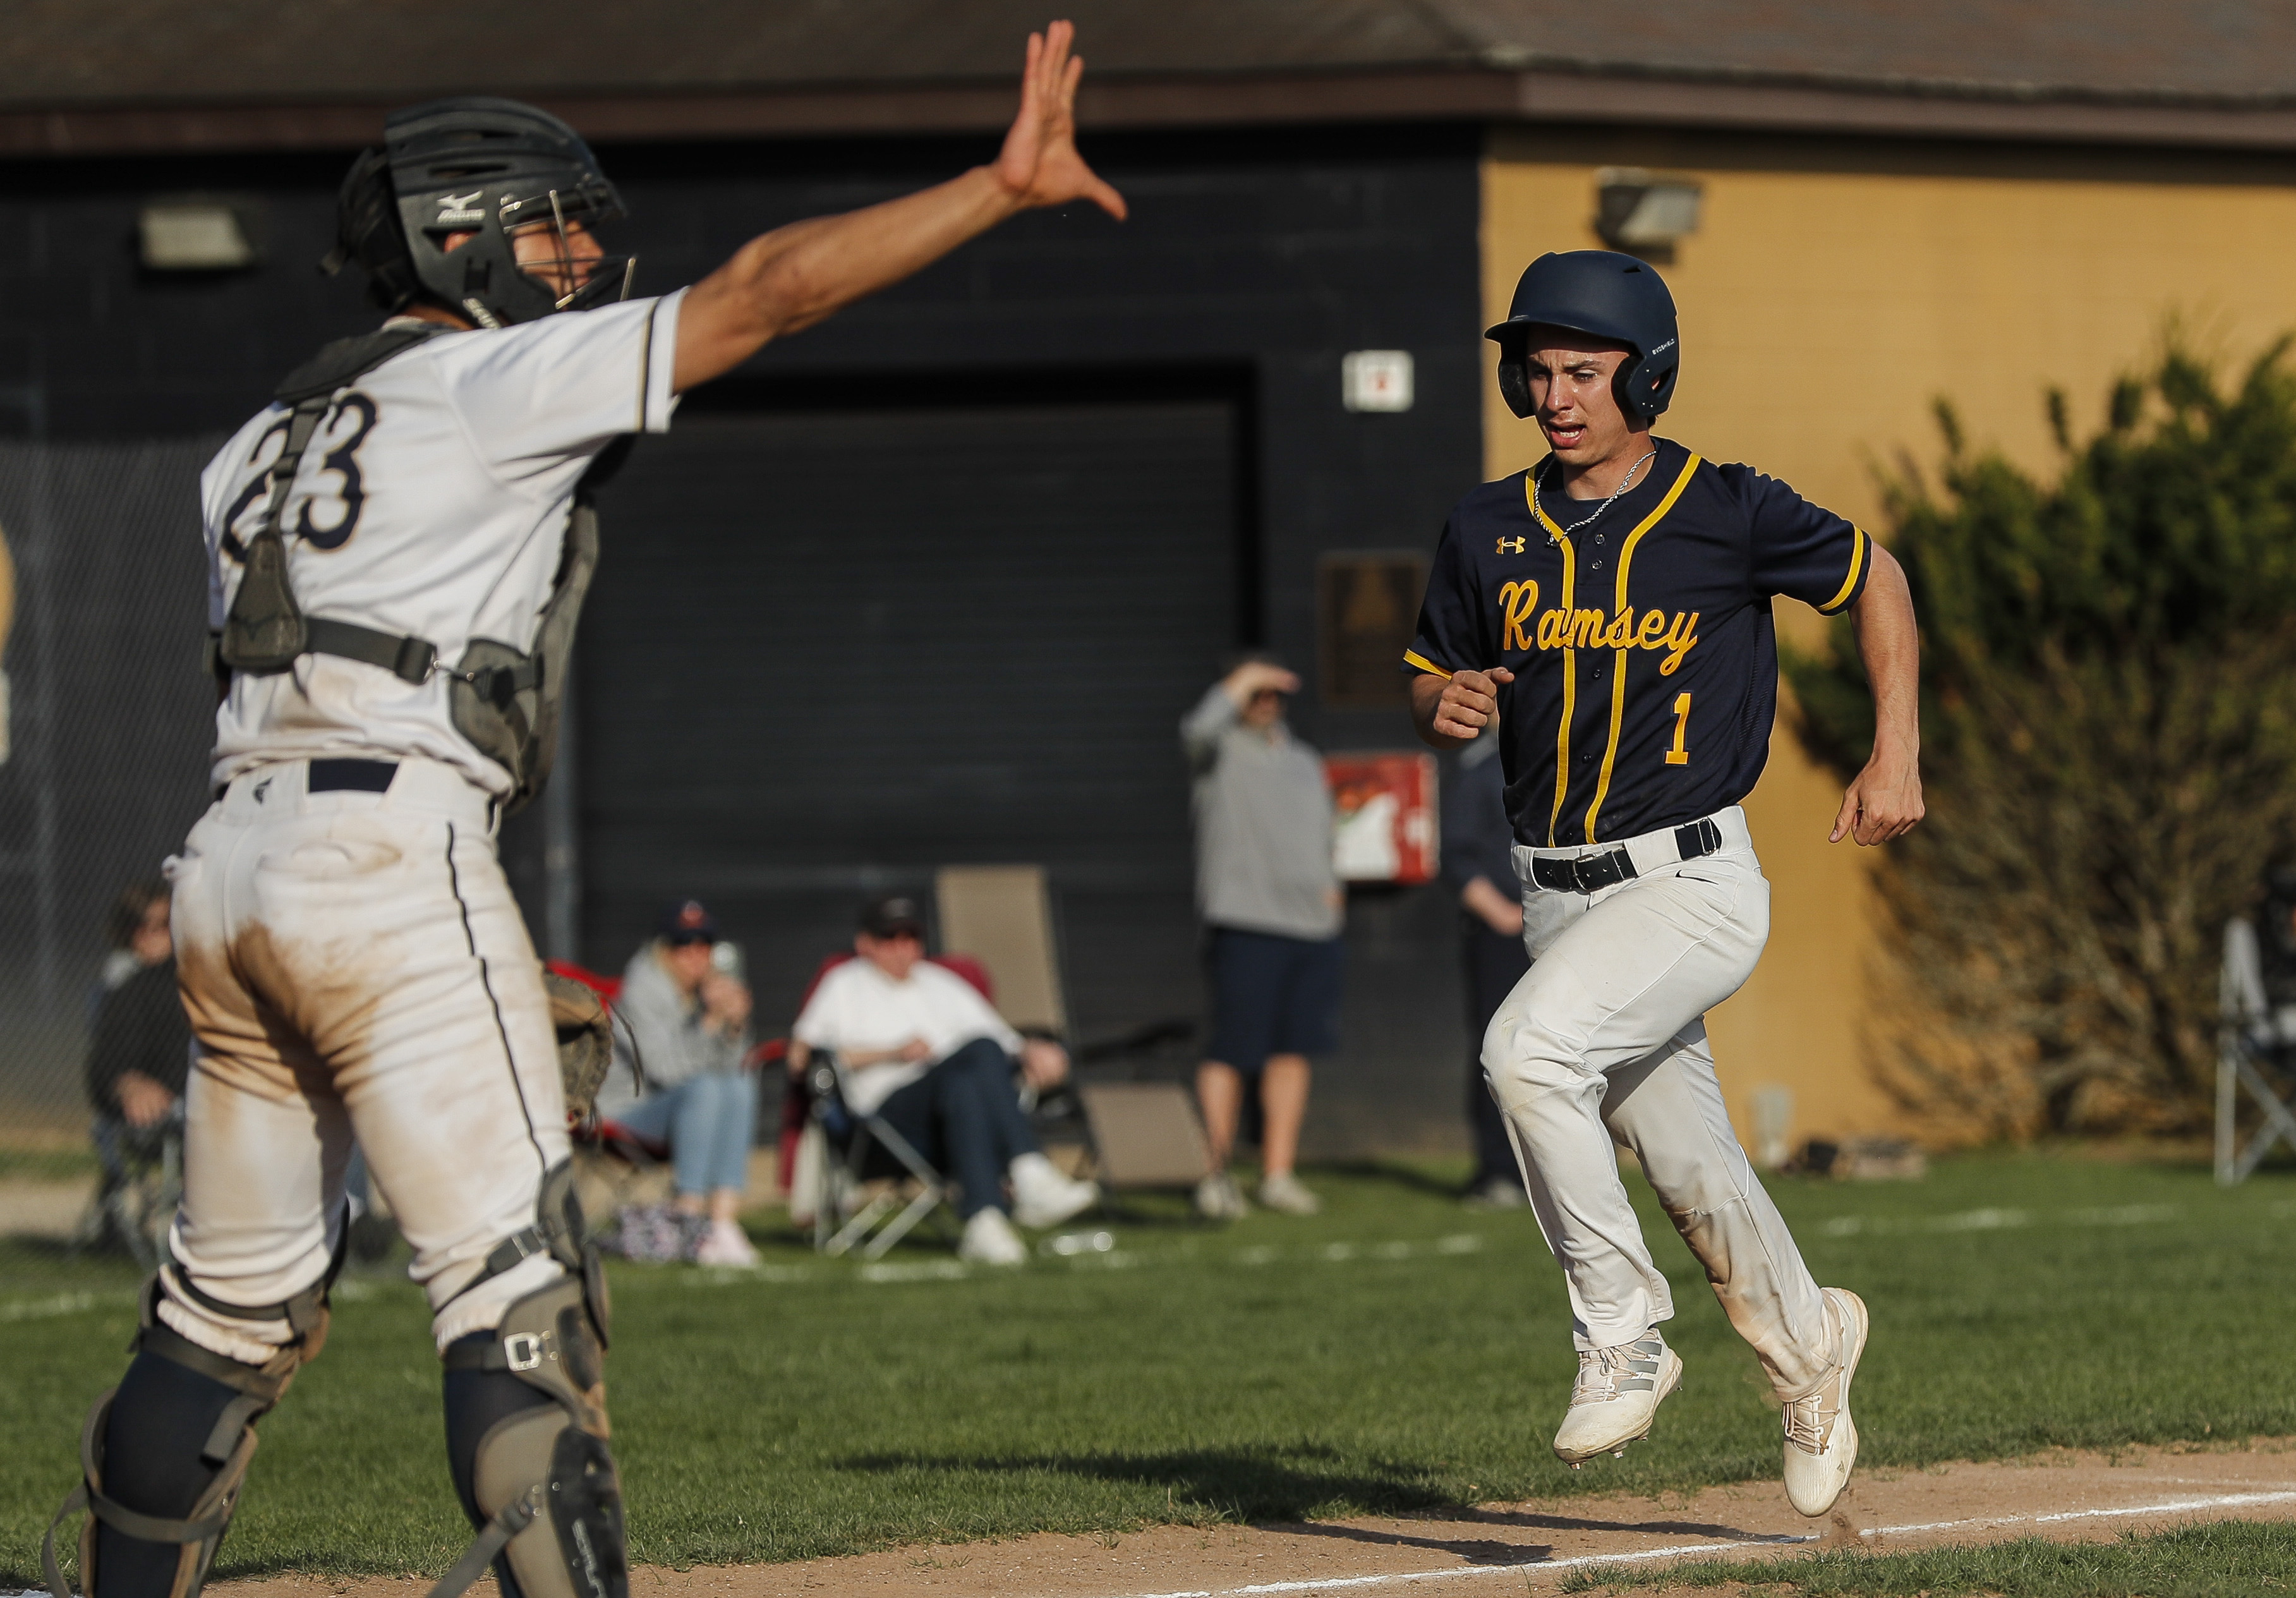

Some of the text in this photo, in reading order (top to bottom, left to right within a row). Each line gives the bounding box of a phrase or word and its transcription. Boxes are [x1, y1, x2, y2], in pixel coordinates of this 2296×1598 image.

[221, 389, 379, 564] 23
[1499, 579, 1700, 676] Ramsey
[1665, 693, 1691, 765] 1
